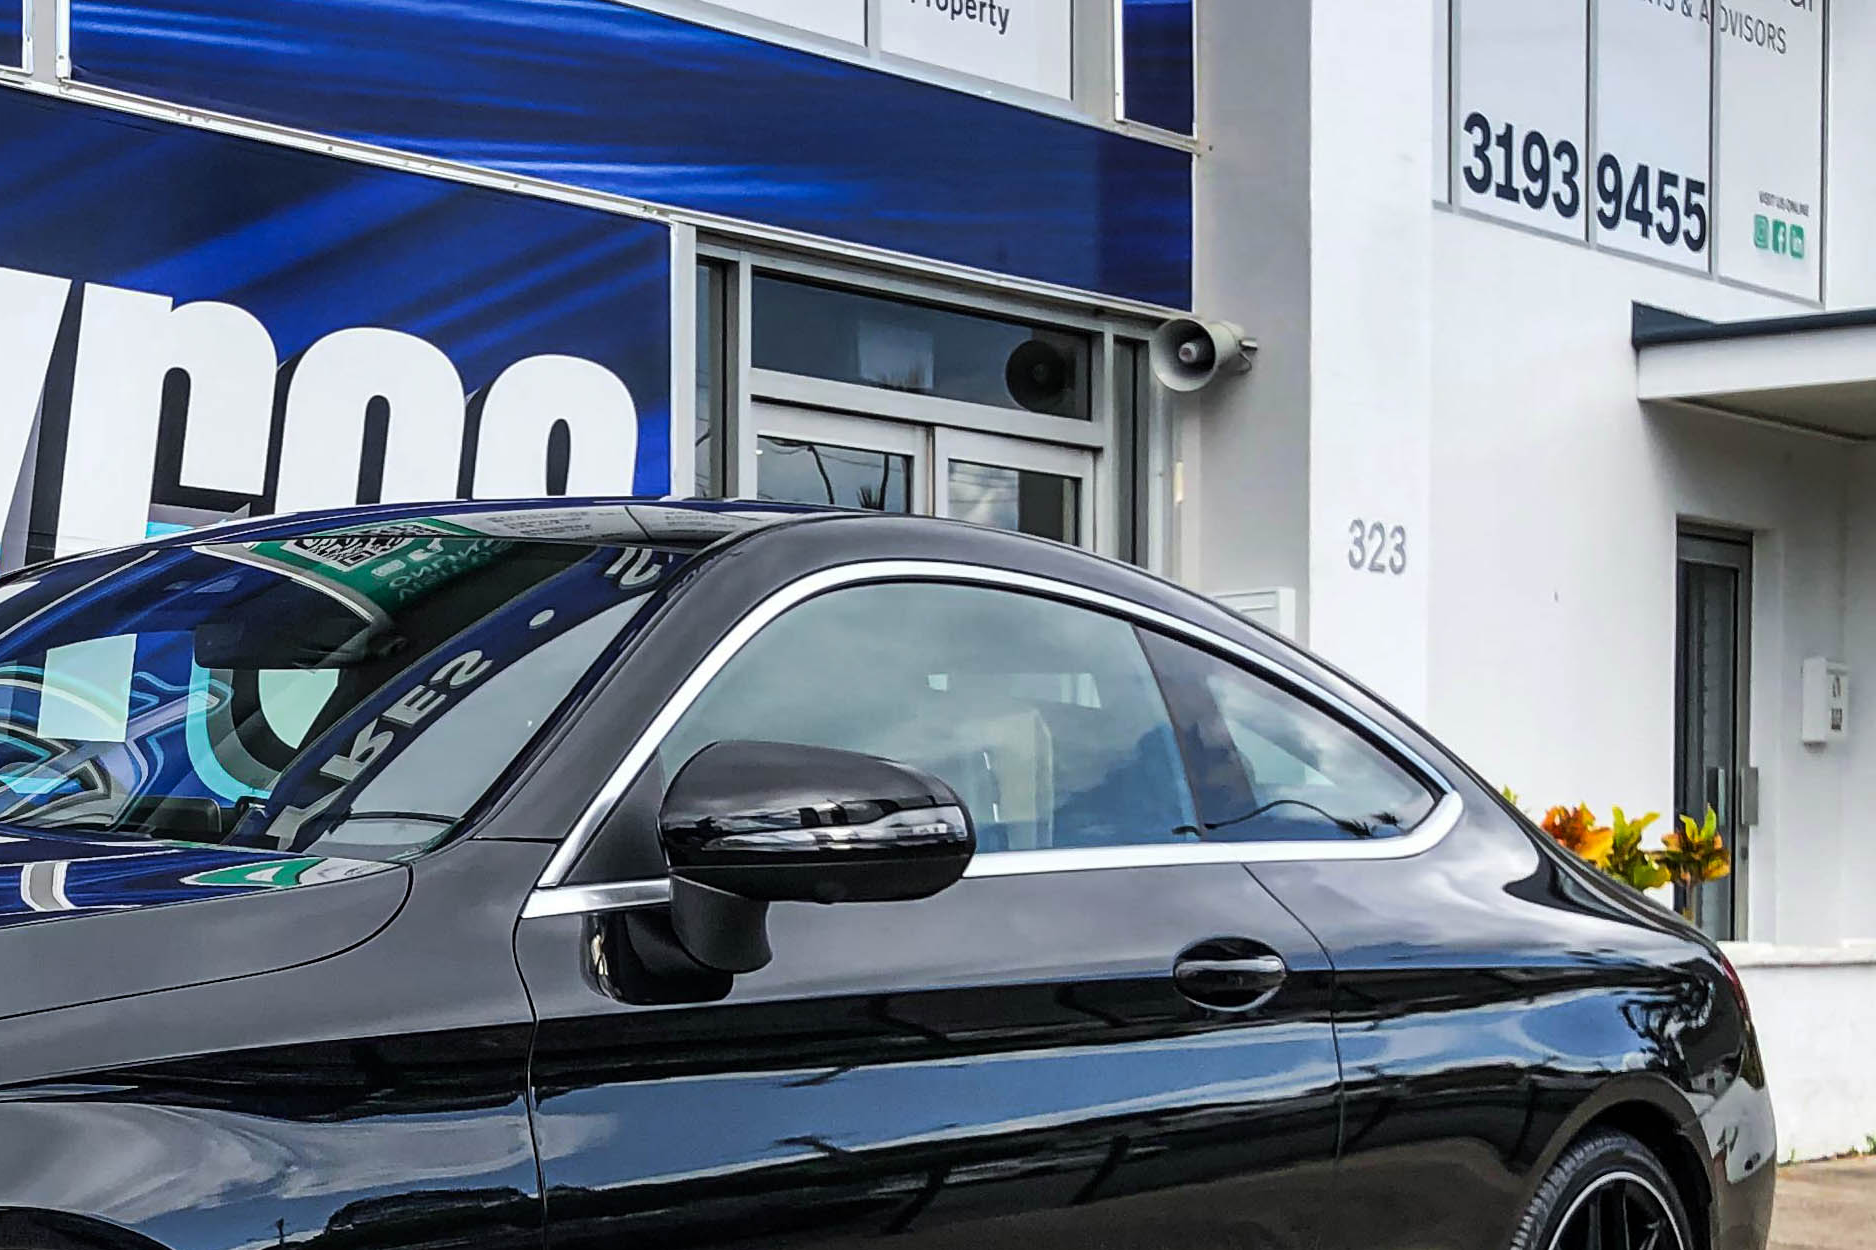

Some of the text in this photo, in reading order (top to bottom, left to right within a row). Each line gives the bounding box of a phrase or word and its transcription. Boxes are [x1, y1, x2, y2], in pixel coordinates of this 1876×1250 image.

[1463, 111, 1708, 253] 3193 9455
[1348, 518, 1406, 575] 323
